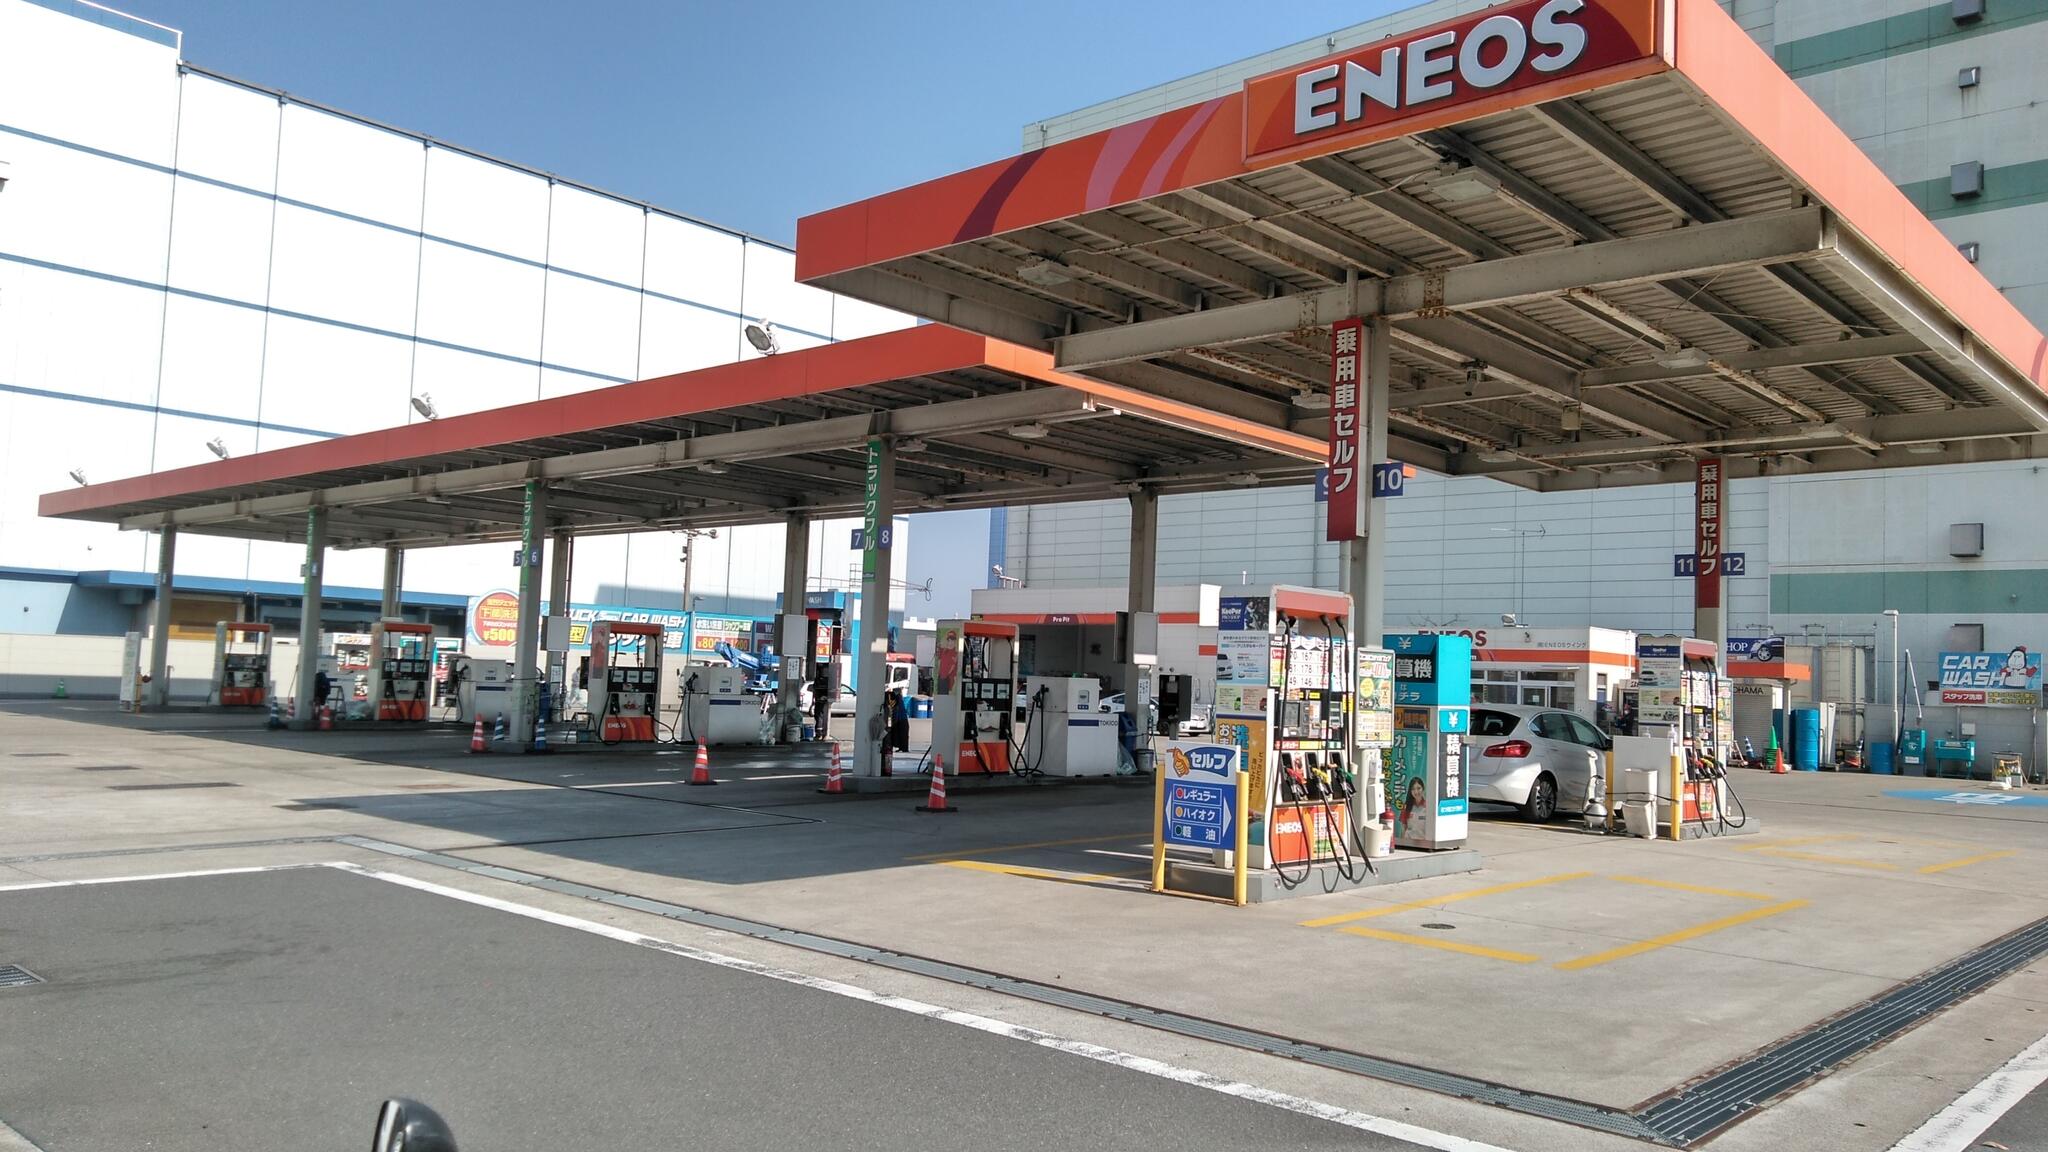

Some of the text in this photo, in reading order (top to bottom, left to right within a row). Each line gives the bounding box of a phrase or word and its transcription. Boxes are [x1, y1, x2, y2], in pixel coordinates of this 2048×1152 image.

[1294, 0, 1588, 135] ENEOS
[1333, 327, 1358, 493] 乗用車セルフ
[1376, 468, 1402, 491] 10
[864, 447, 878, 551] トラックフル
[1701, 464, 1718, 576] 乗用車セルフ
[854, 532, 861, 546] 7
[881, 529, 889, 544] 8
[531, 551, 537, 563] 6
[1723, 557, 1744, 572] 12
[1677, 558, 1694, 573] 11
[1942, 655, 1990, 670] CAR
[1942, 671, 2007, 686] WASH
[1191, 751, 1227, 770] セルフ
[1446, 733, 1461, 798] 精算機
[1183, 788, 1217, 802] レギュラー
[1183, 807, 1216, 821] ハイオク
